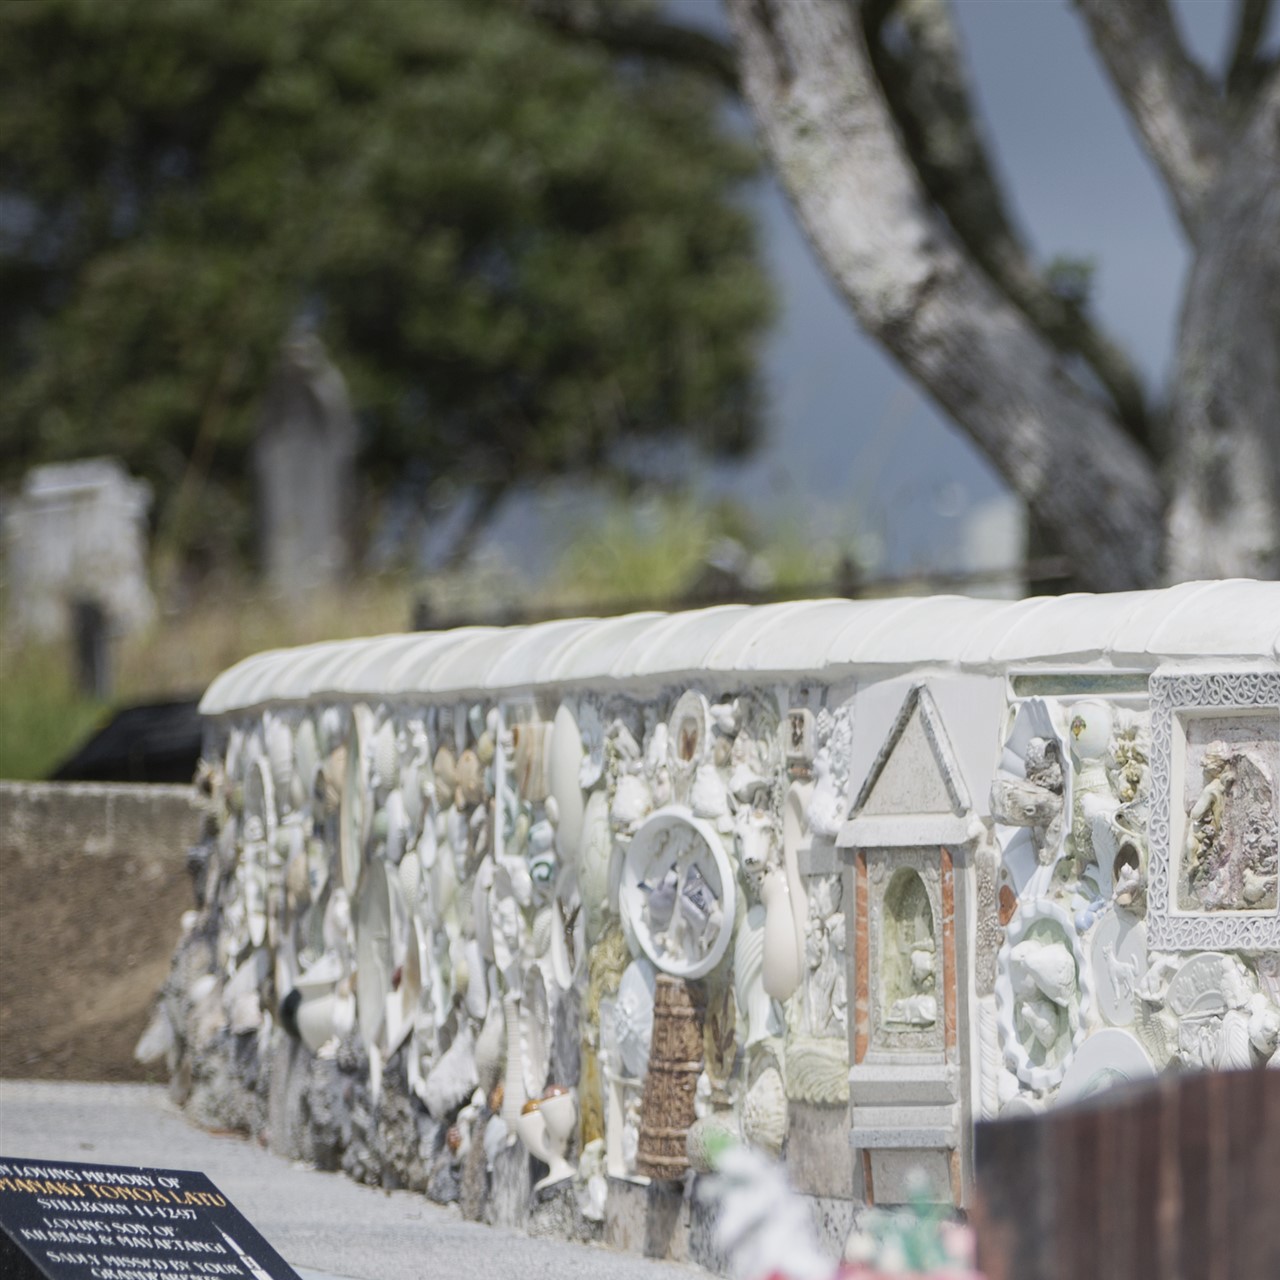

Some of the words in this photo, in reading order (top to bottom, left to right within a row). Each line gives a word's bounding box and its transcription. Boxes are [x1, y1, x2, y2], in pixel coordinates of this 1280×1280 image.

[13, 1165, 82, 1181] LOVING
[81, 1170, 156, 1187] MEMORY
[158, 1177, 180, 1189] OF
[36, 1198, 132, 1216] STILLBORN
[168, 1189, 227, 1207] LATU
[43, 1217, 112, 1233] LOVING
[111, 1222, 152, 1235] SON
[152, 1225, 175, 1237] OF
[46, 1251, 100, 1266] SADLY
[102, 1255, 168, 1270] MISSED
[168, 1260, 192, 1271] BY
[192, 1261, 244, 1276] YOUR
